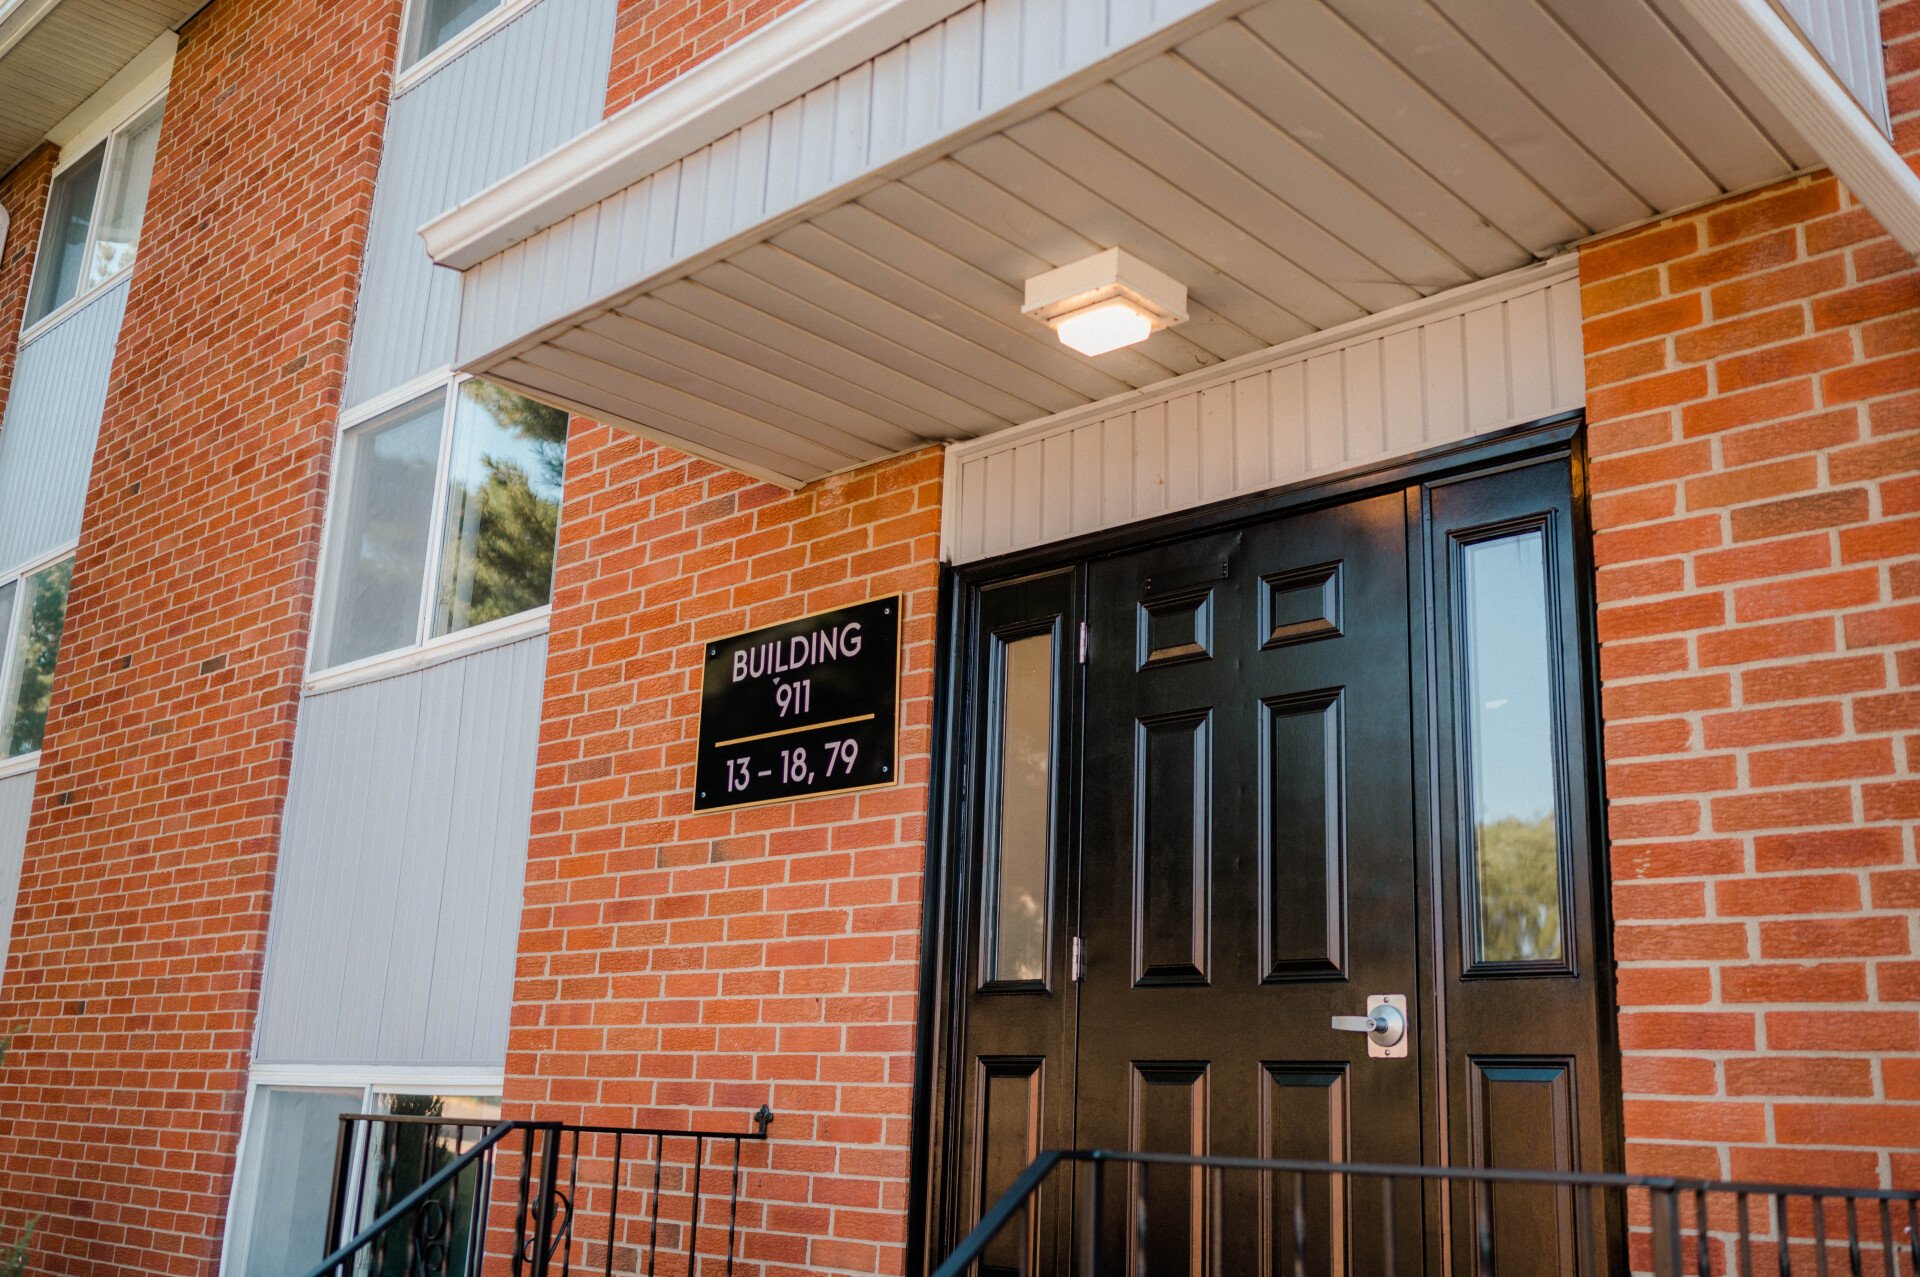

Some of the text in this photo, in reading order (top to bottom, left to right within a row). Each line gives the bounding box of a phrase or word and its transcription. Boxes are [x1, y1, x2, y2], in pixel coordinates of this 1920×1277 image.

[732, 622, 862, 683] BUILDING
[775, 679, 811, 718] 911
[726, 756, 751, 792] 13
[780, 747, 815, 785] 18,
[824, 738, 859, 777] 79
